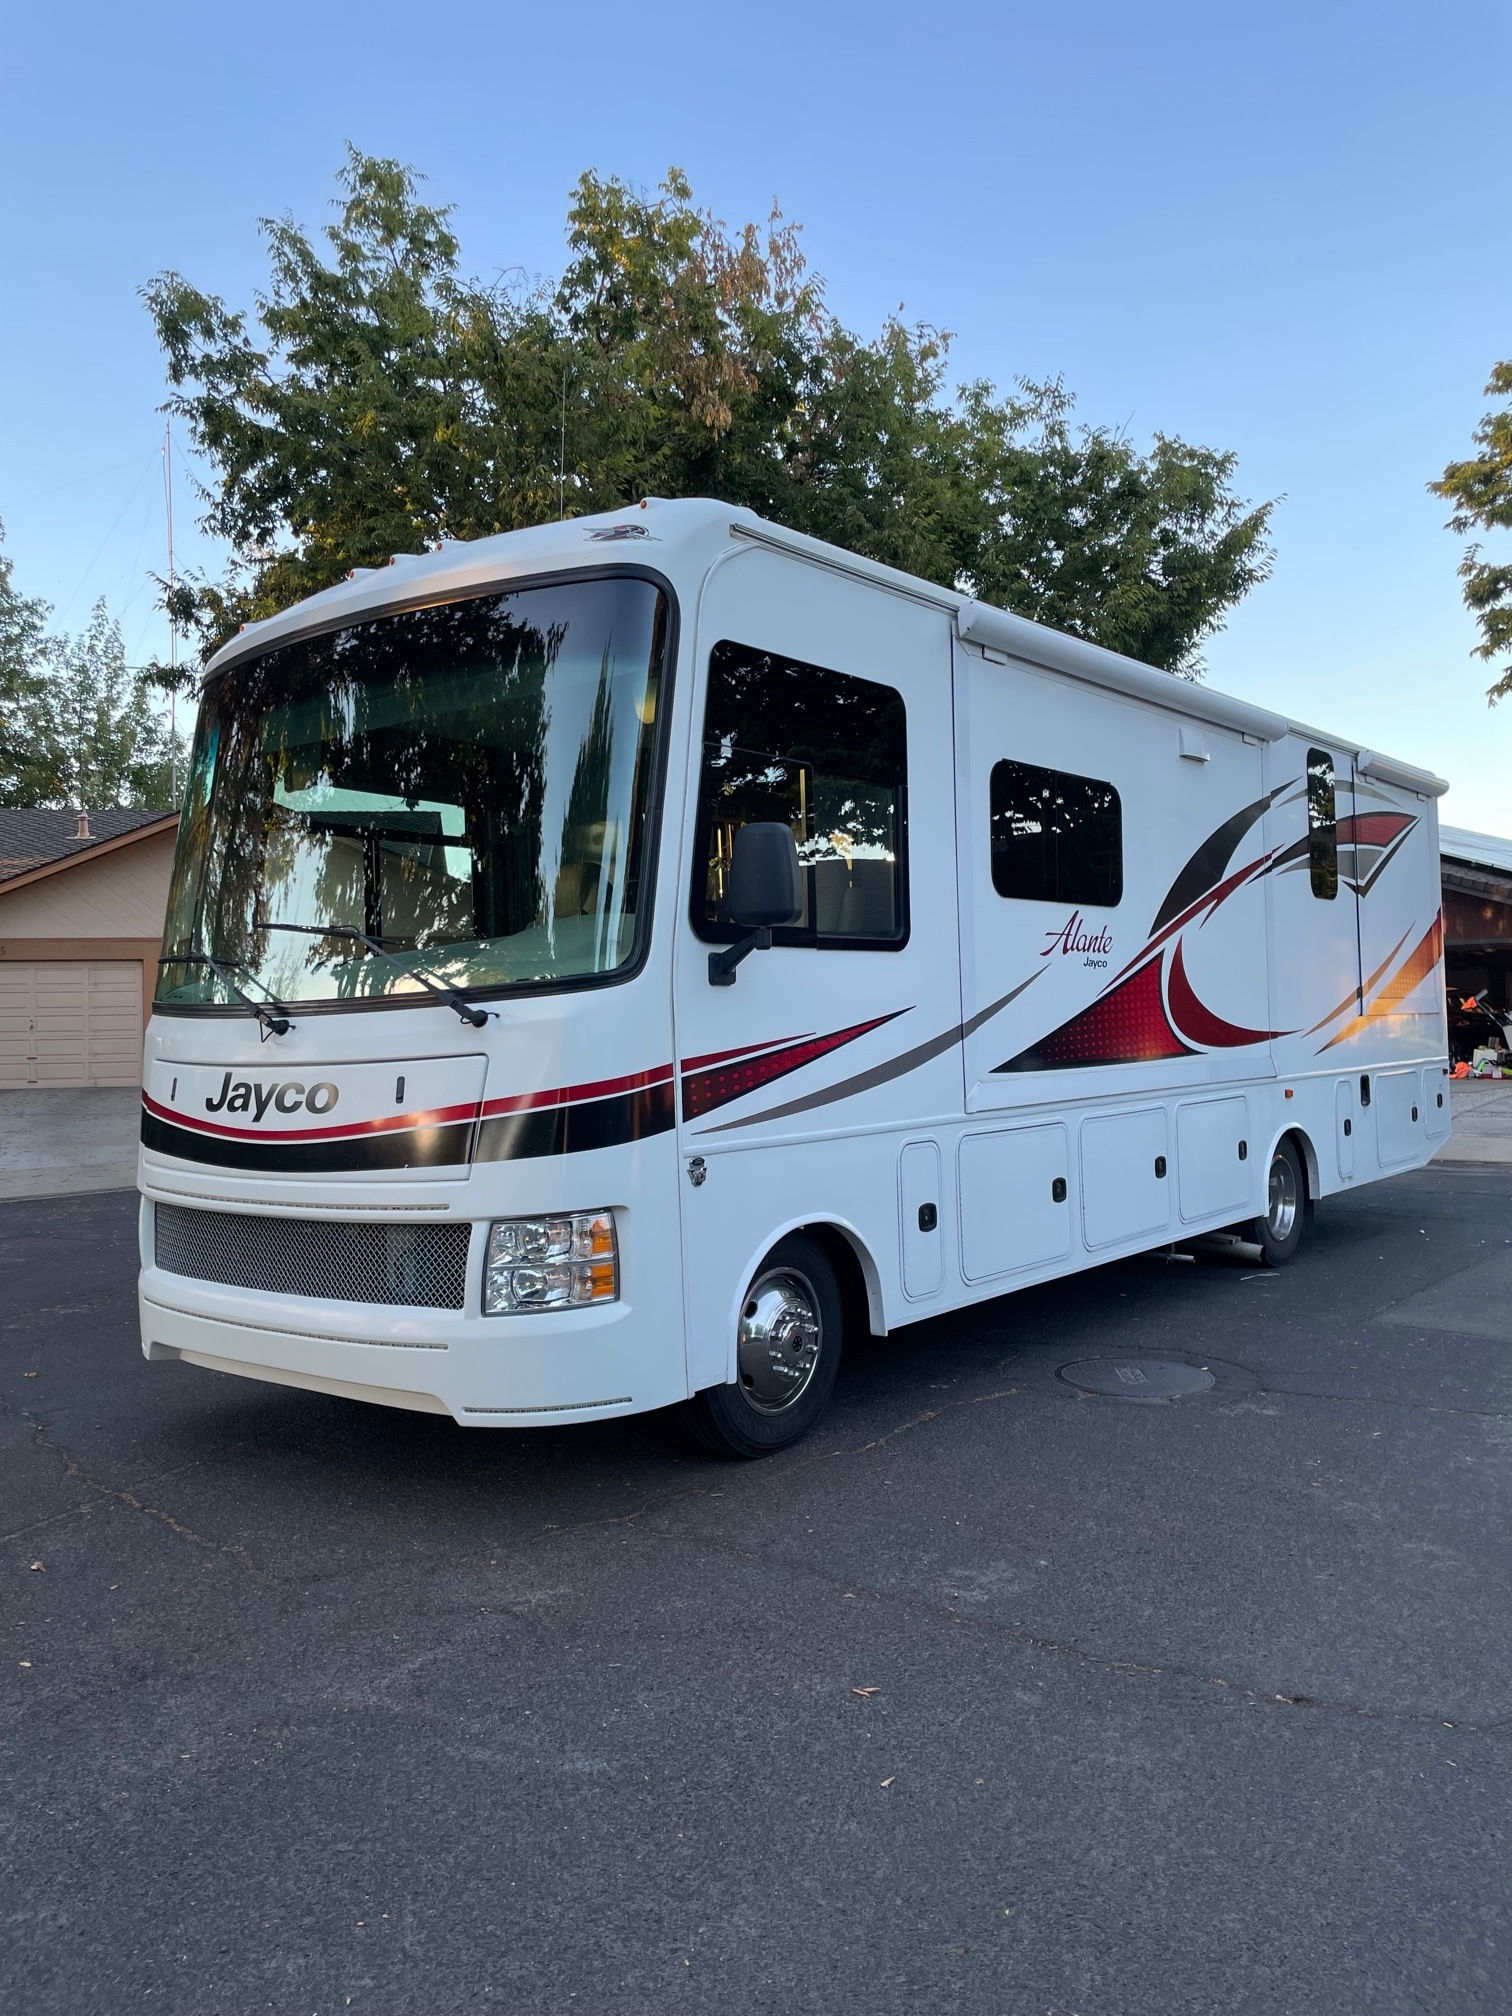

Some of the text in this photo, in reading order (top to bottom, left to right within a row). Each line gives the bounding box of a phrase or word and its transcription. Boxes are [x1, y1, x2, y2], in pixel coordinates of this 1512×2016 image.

[1040, 910, 1113, 956] Alante
[1083, 957, 1108, 969] Jayco
[205, 1072, 340, 1122] Jayco
